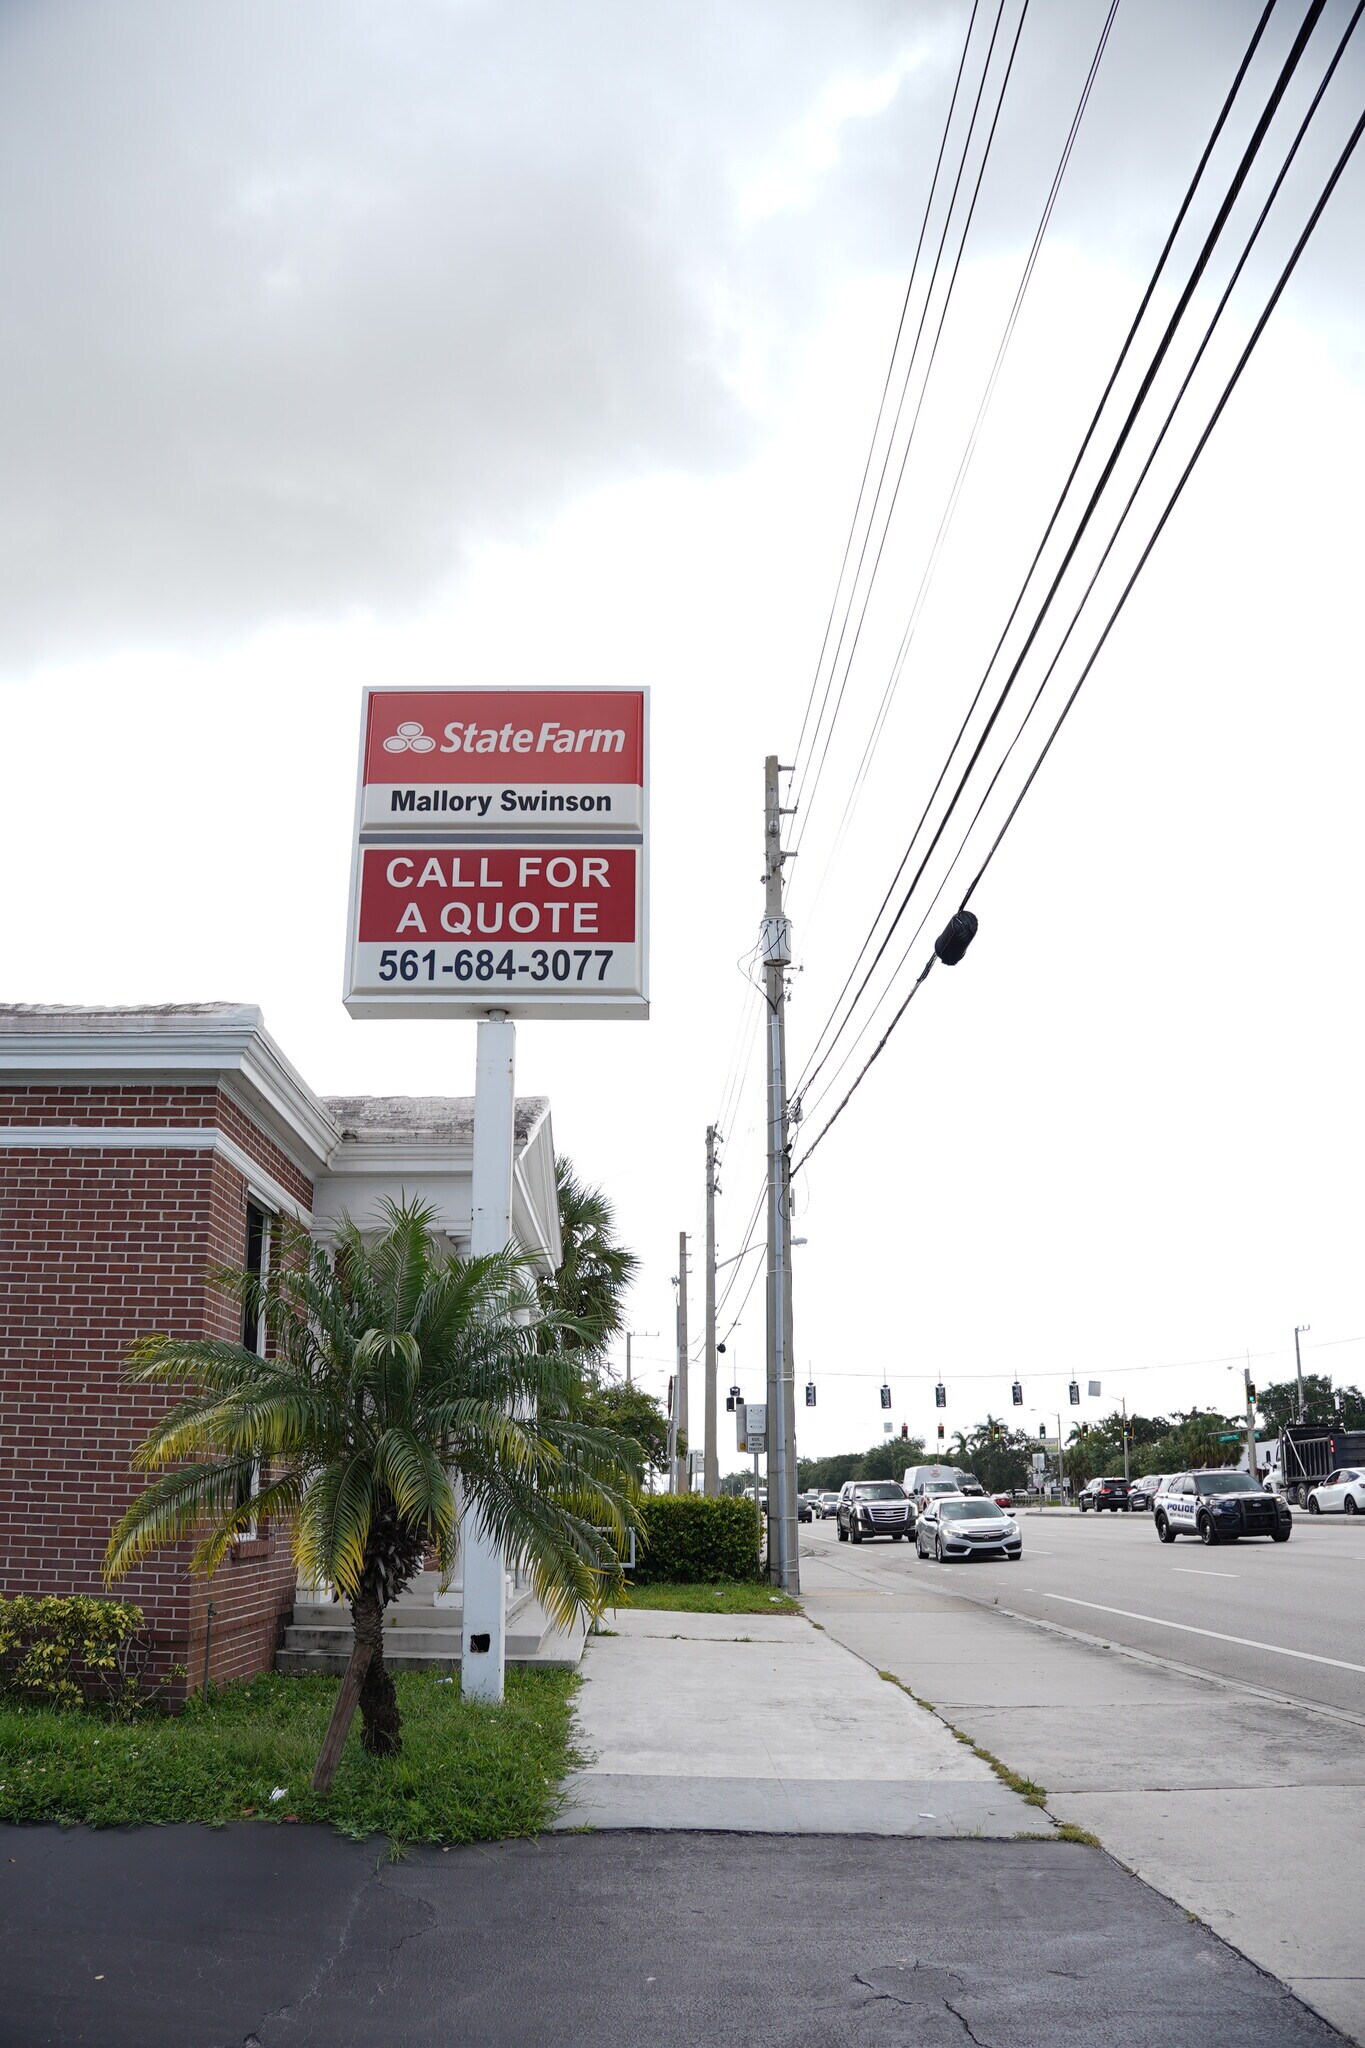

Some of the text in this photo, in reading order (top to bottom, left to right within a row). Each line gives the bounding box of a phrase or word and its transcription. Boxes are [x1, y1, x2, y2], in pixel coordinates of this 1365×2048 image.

[390, 789, 612, 816] Mallory Swinson
[386, 856, 611, 888] CALL FOR
[395, 902, 599, 936] A QUOTE
[378, 949, 614, 981] 561-684-3077
[1167, 1503, 1194, 1513] POLICE
